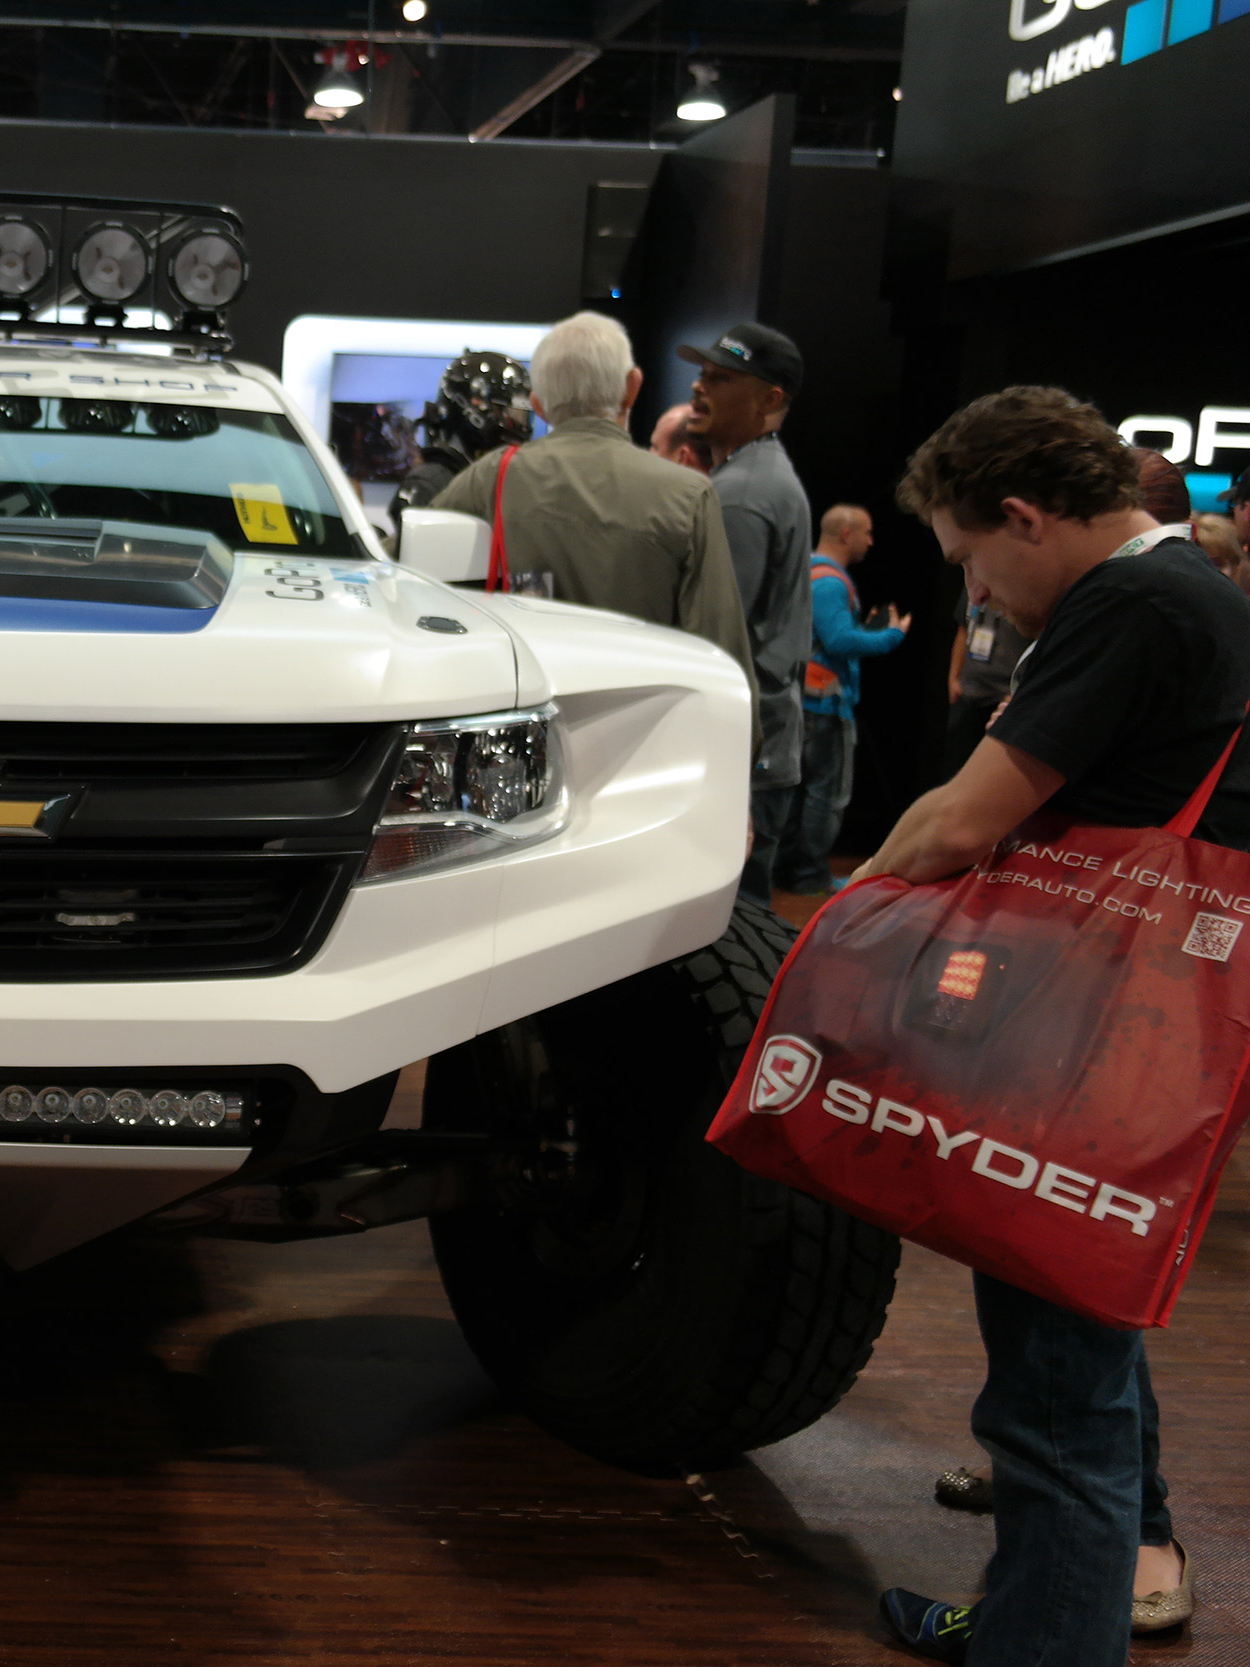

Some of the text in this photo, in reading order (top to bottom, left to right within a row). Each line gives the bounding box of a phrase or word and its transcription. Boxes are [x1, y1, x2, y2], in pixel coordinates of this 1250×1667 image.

[69, 374, 238, 392] SHOP
[973, 864, 1162, 926] YDERAUTO.COM
[821, 1079, 1157, 1237] SPYDER
